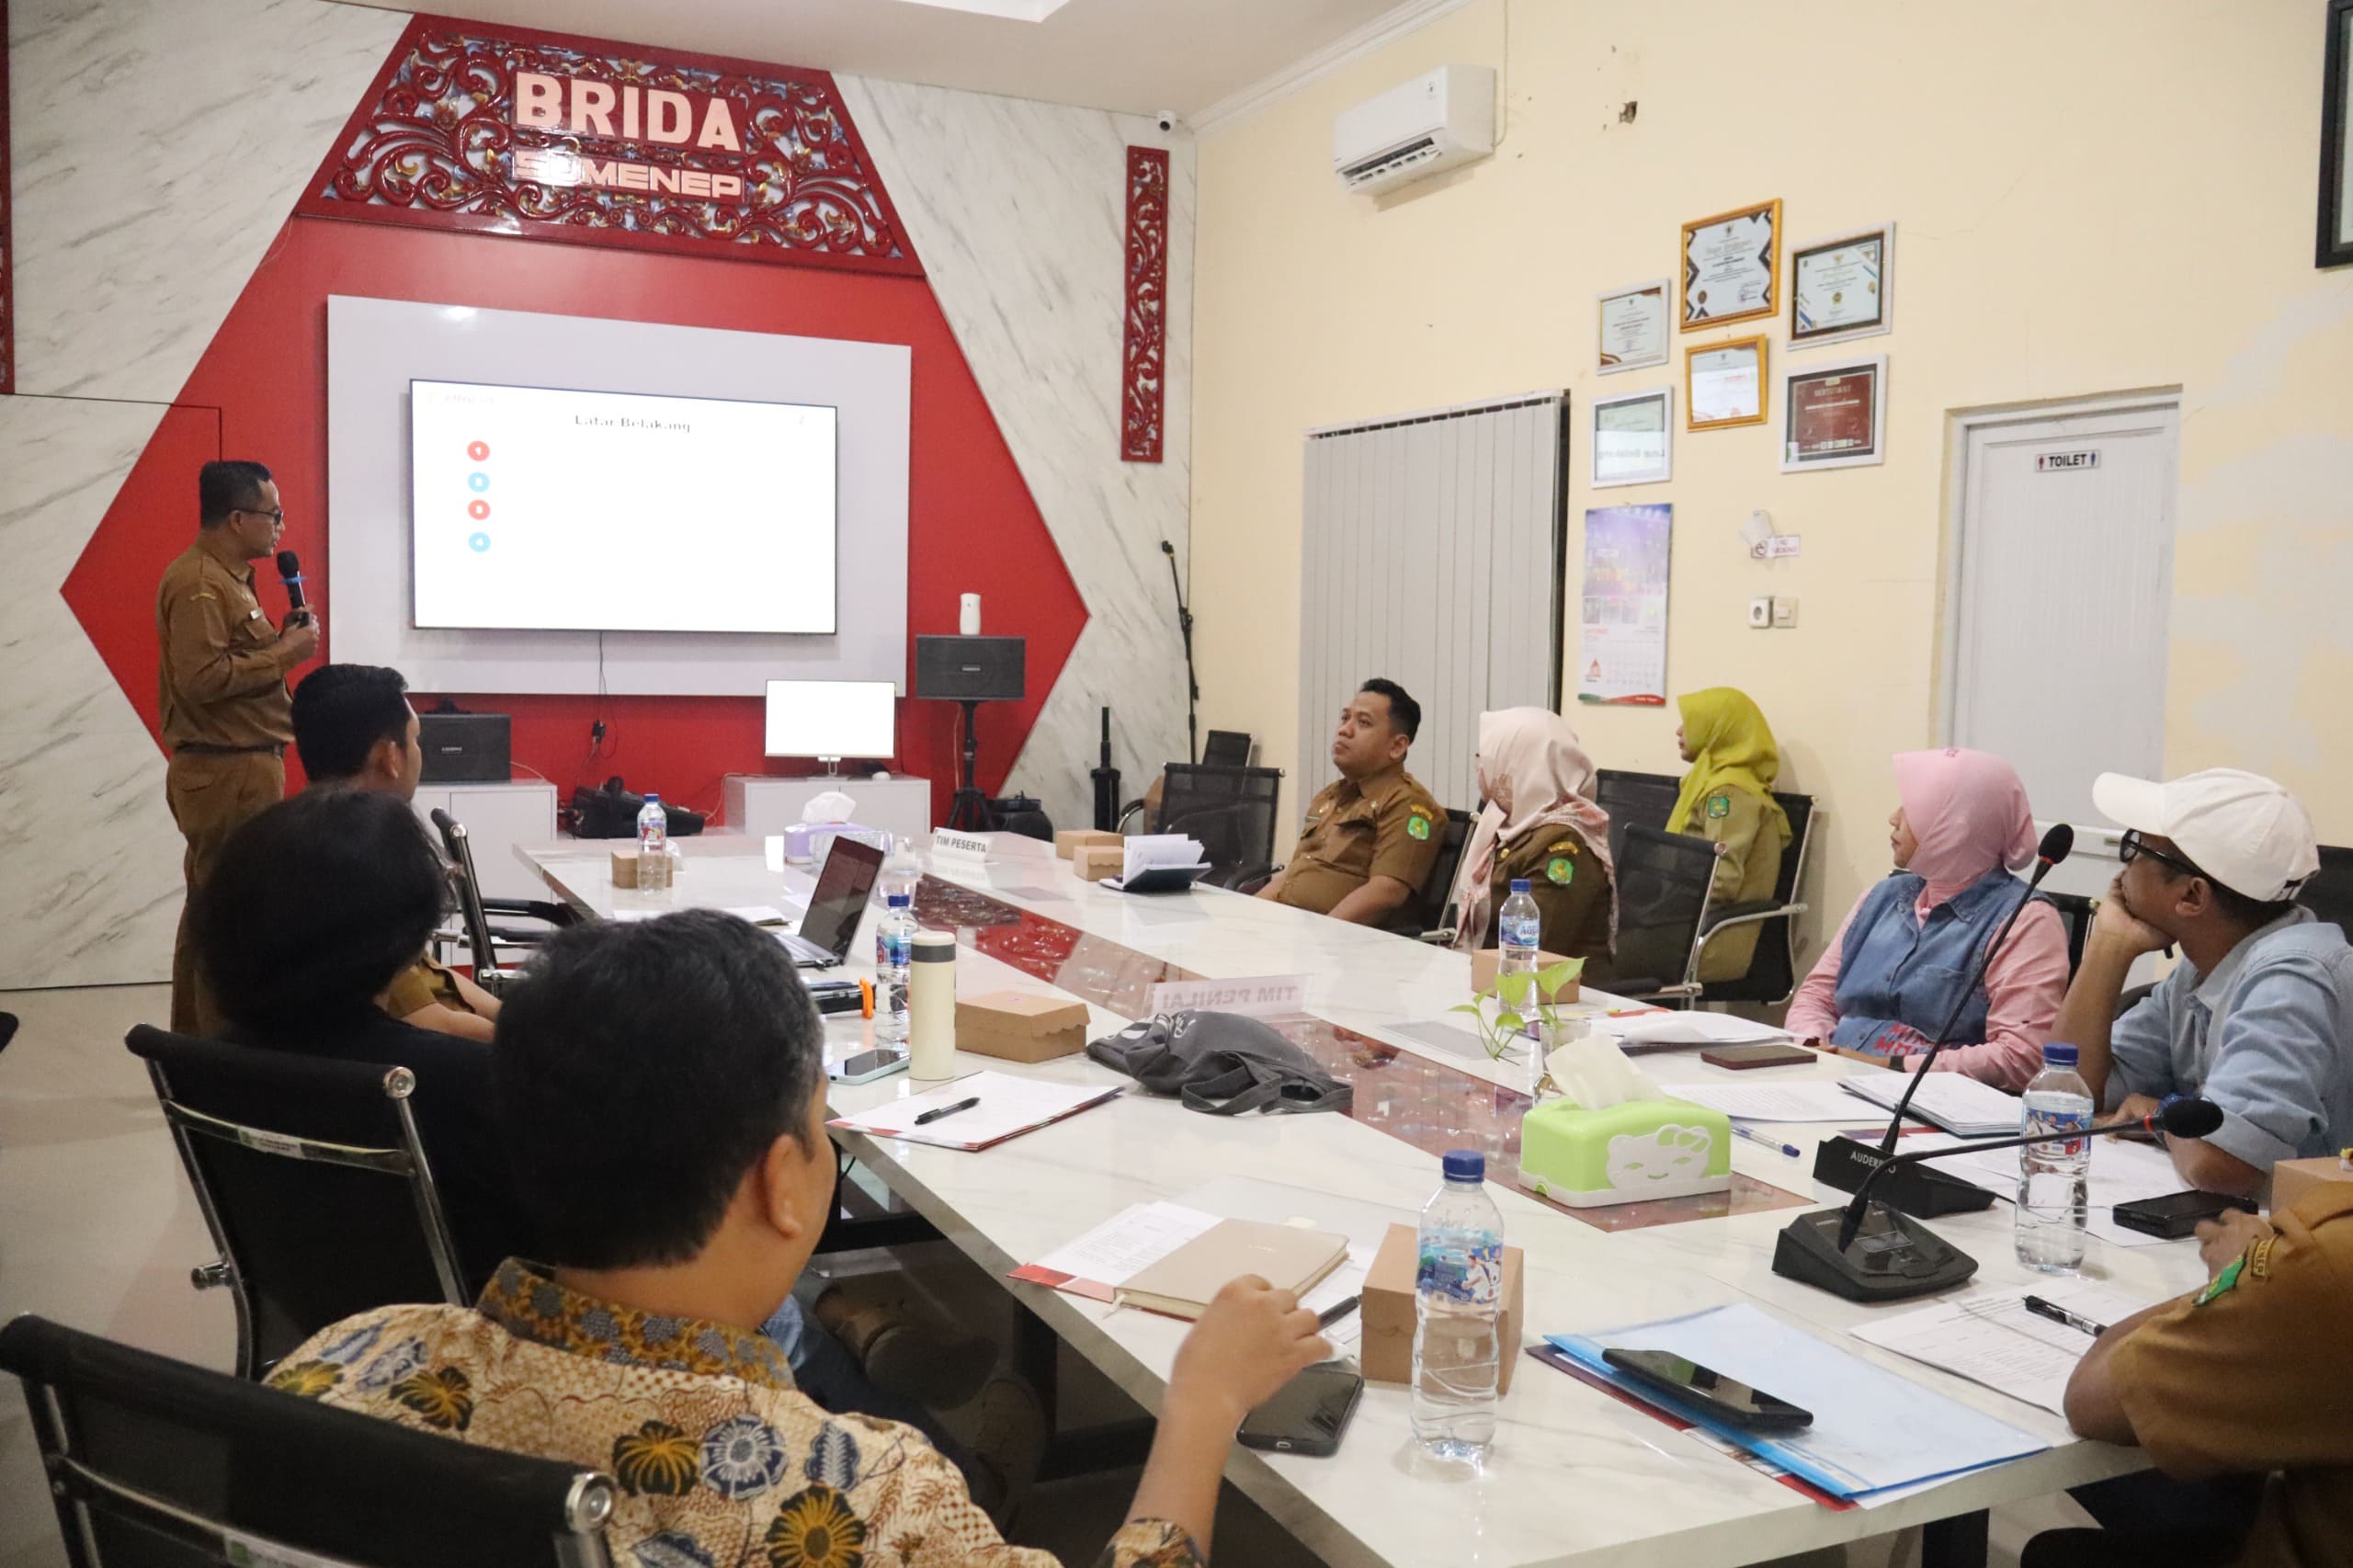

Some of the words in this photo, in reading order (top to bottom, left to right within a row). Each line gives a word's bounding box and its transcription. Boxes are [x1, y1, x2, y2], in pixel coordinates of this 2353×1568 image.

[516, 72, 741, 153] BRIDA
[2049, 453, 2087, 467] TOILET
[936, 835, 949, 846] TIM
[950, 837, 986, 853] PESERTA
